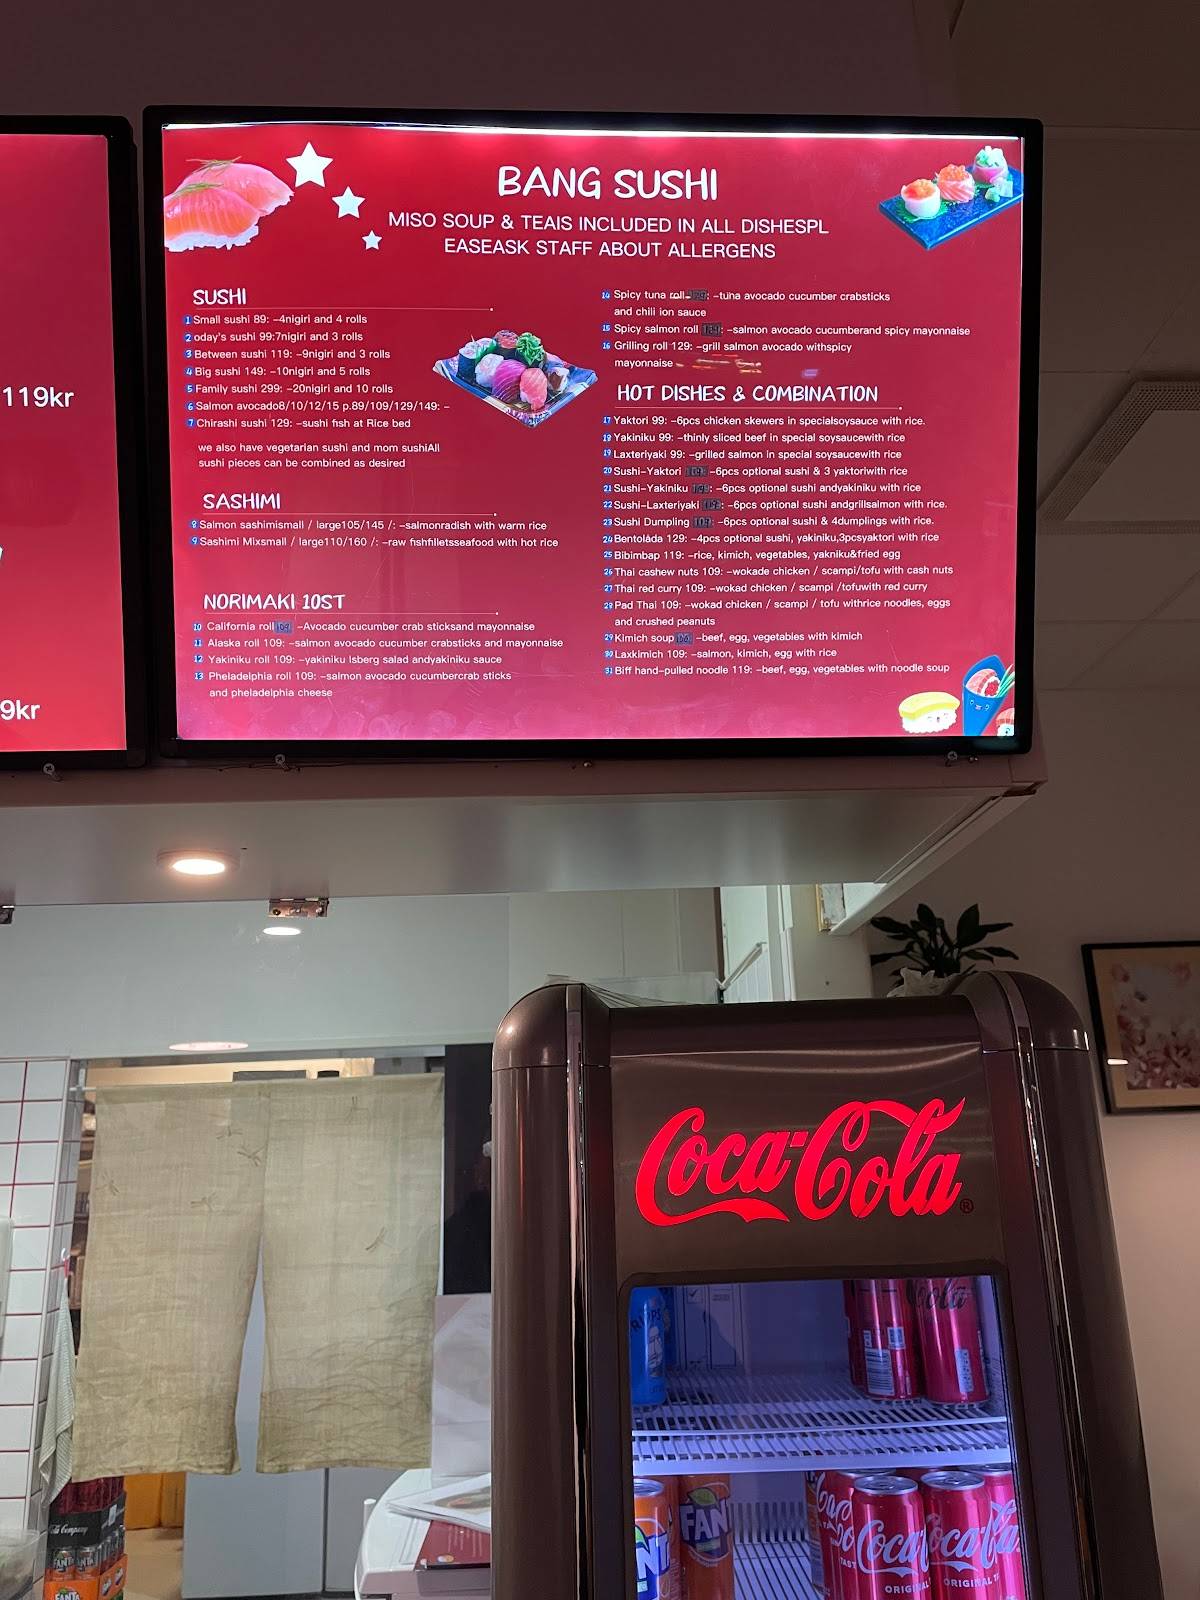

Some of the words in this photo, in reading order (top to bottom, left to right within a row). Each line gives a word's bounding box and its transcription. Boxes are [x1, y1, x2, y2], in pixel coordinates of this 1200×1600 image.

[498, 165, 601, 199] BANG
[614, 166, 718, 200] SUSHI
[389, 212, 437, 228] MISO
[442, 213, 495, 229] SOUP
[500, 214, 514, 230] &
[520, 215, 573, 231] TEAIS
[579, 217, 672, 232] INCLUDED
[678, 218, 695, 233] IN
[701, 218, 735, 234] ALL
[741, 218, 829, 234] DISHESPL
[444, 238, 530, 255] EASEASK
[536, 240, 593, 256] STAFF
[598, 241, 662, 257] ABOUT
[667, 242, 776, 258] ALLERGENS
[192, 287, 247, 306] SUSHI
[613, 289, 642, 301] Spicy
[644, 290, 666, 300] tuna
[614, 306, 633, 316] and
[635, 306, 656, 316] chili
[659, 307, 675, 317] ion
[677, 309, 707, 317] sauce
[193, 314, 221, 325] Small
[223, 314, 250, 324] sushi
[253, 314, 270, 324] 89:
[614, 323, 642, 335] Spicy
[644, 324, 680, 334] salmon
[683, 324, 699, 334] roll
[193, 332, 227, 344] oday's
[229, 332, 256, 342] sushi
[310, 331, 329, 341] and
[331, 331, 339, 341] 3
[341, 331, 364, 342] rolls
[614, 340, 650, 353] Grilling
[652, 341, 668, 351] roll
[671, 341, 693, 351] 129:
[723, 342, 759, 351] salmon
[761, 342, 804, 352] avocado
[805, 342, 852, 354] withspicy
[194, 349, 238, 359] Between
[240, 349, 267, 359] sushi
[271, 349, 293, 359] 119:
[614, 358, 674, 369] mayonnaise
[194, 366, 212, 379] Big
[214, 366, 241, 376] sushi
[244, 366, 266, 376] 149:
[195, 383, 228, 396] Family
[231, 383, 258, 394] sushi
[260, 383, 283, 393] 299:
[617, 384, 655, 401] HOT
[661, 384, 726, 402] DISHES
[732, 385, 746, 402] &
[752, 385, 878, 402] COMBINATION
[2, 386, 75, 408] 119kr
[194, 401, 234, 411] Salmon
[196, 418, 238, 428] Chirashi
[240, 418, 267, 428] sushi
[271, 418, 293, 428] 129:
[613, 415, 649, 425] Yaktori
[651, 415, 668, 425] 99:
[703, 415, 742, 426] chicken
[744, 416, 785, 426] skewers
[787, 416, 797, 425] in
[799, 416, 879, 427] specialsoysauce
[881, 416, 902, 426] with
[904, 416, 926, 426] rice.
[613, 432, 656, 442] Yakiniku
[658, 432, 674, 442] 99:
[198, 444, 213, 452] we
[215, 443, 237, 452] also
[239, 442, 264, 452] have
[266, 442, 319, 454] vegetarian
[321, 443, 348, 452] sushi
[351, 443, 371, 452] and
[373, 445, 399, 453] mom
[401, 443, 440, 453] sushiAll
[613, 449, 667, 461] Laxteriyaki
[669, 449, 686, 459] 99:
[198, 458, 225, 468] sushi
[228, 458, 261, 470] pieces
[263, 459, 283, 468] can
[285, 458, 299, 468] be
[301, 458, 351, 468] combined
[353, 460, 366, 468] as
[368, 458, 406, 468] desired
[202, 492, 281, 510] SASHIMI
[199, 520, 237, 530] Salmon
[239, 520, 305, 530] sashimismall
[613, 517, 641, 527] Sushi
[643, 516, 690, 529] Dumpling
[199, 536, 240, 546] Sashimi
[242, 536, 287, 546] Mixsmall
[666, 533, 688, 543] 129:
[614, 550, 661, 562] Bibimbap
[663, 550, 685, 560] 119:
[613, 567, 635, 577] Thai
[638, 567, 676, 577] cashew
[677, 567, 700, 577] nuts
[702, 566, 724, 576] 109:
[614, 583, 636, 593] Thai
[638, 584, 655, 593] red
[657, 585, 683, 595] curry
[685, 583, 706, 593] 109:
[204, 593, 295, 610] NORIMAKI
[302, 593, 346, 610] 10ST
[613, 600, 634, 610] Pad
[635, 600, 657, 610] Thai
[661, 600, 682, 610] 109:
[206, 621, 256, 631] California
[258, 621, 275, 632] roll
[614, 616, 633, 627] and
[635, 616, 674, 626] crushed
[676, 617, 716, 628] peanuts
[207, 638, 241, 648] Alaska
[244, 638, 260, 648] roll
[263, 638, 285, 648] 109:
[614, 633, 648, 643] Kimich
[650, 635, 675, 644] soup
[208, 655, 251, 664] Yakiniku
[254, 655, 270, 664] roll
[274, 654, 295, 664] 109:
[614, 649, 664, 659] Laxkimich
[667, 649, 688, 659] 109:
[614, 666, 632, 675] Biff
[696, 665, 729, 675] noodle
[732, 664, 753, 674] 119:
[208, 671, 273, 682] Pheladelphia
[275, 671, 292, 681] roll
[295, 671, 317, 681] 109:
[209, 688, 228, 698] and
[231, 688, 295, 699] pheladelphia
[297, 688, 333, 697] cheese
[635, 1097, 966, 1226] Coca-Cola
